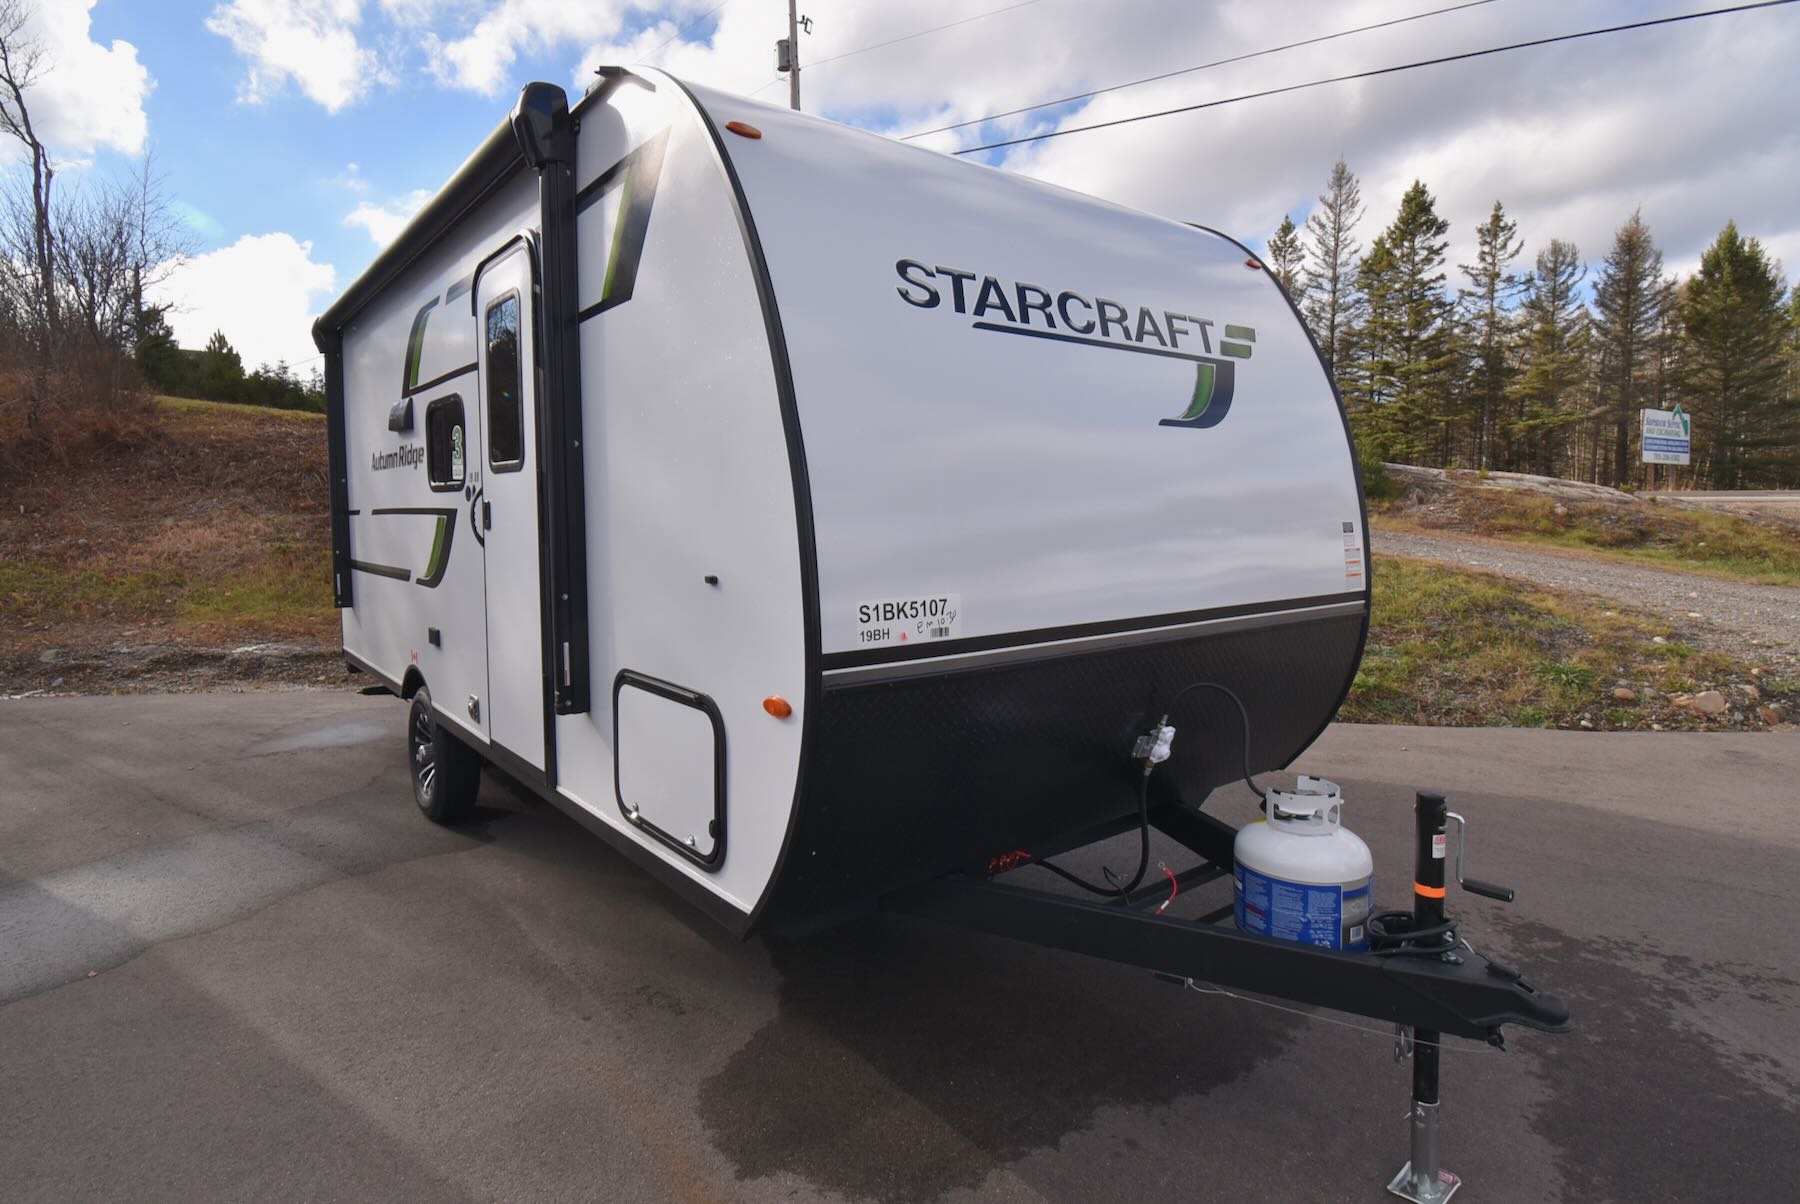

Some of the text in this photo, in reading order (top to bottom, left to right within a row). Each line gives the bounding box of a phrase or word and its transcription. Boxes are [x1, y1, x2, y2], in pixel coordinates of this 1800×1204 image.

[895, 258, 1215, 355] STARCRAFT
[371, 442, 425, 472] Autumn Ridge
[859, 598, 948, 623] S1BK5107
[860, 628, 890, 642] 19BH
